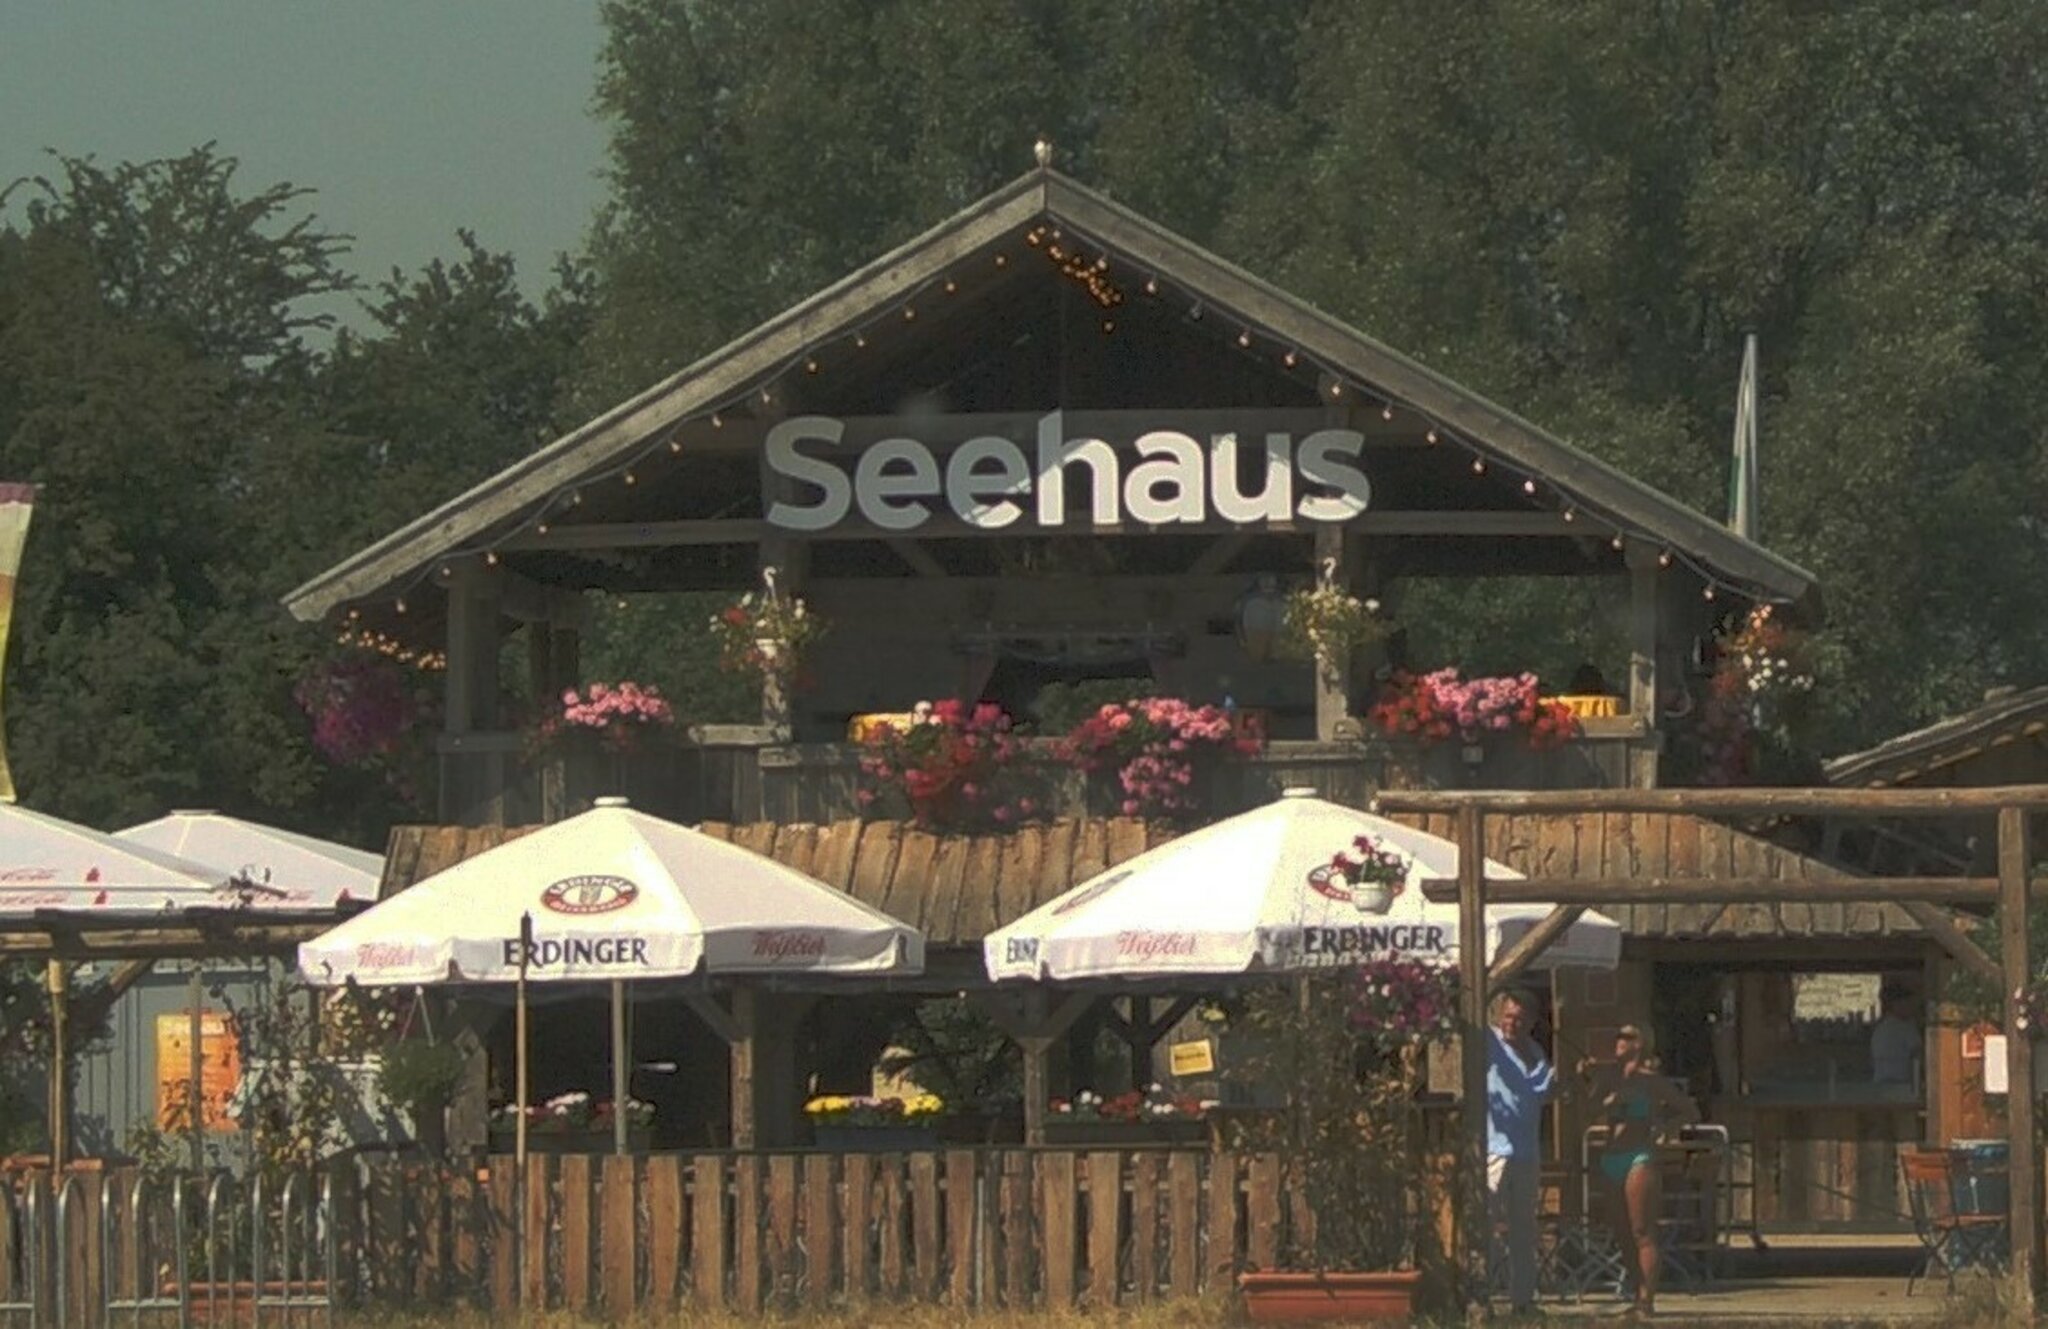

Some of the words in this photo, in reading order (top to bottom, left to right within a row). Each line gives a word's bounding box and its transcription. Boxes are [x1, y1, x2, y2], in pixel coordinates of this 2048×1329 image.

[765, 409, 1371, 531] Seehaus
[503, 938, 648, 968] ERDINGER
[1303, 925, 1446, 954] ERDINGER
